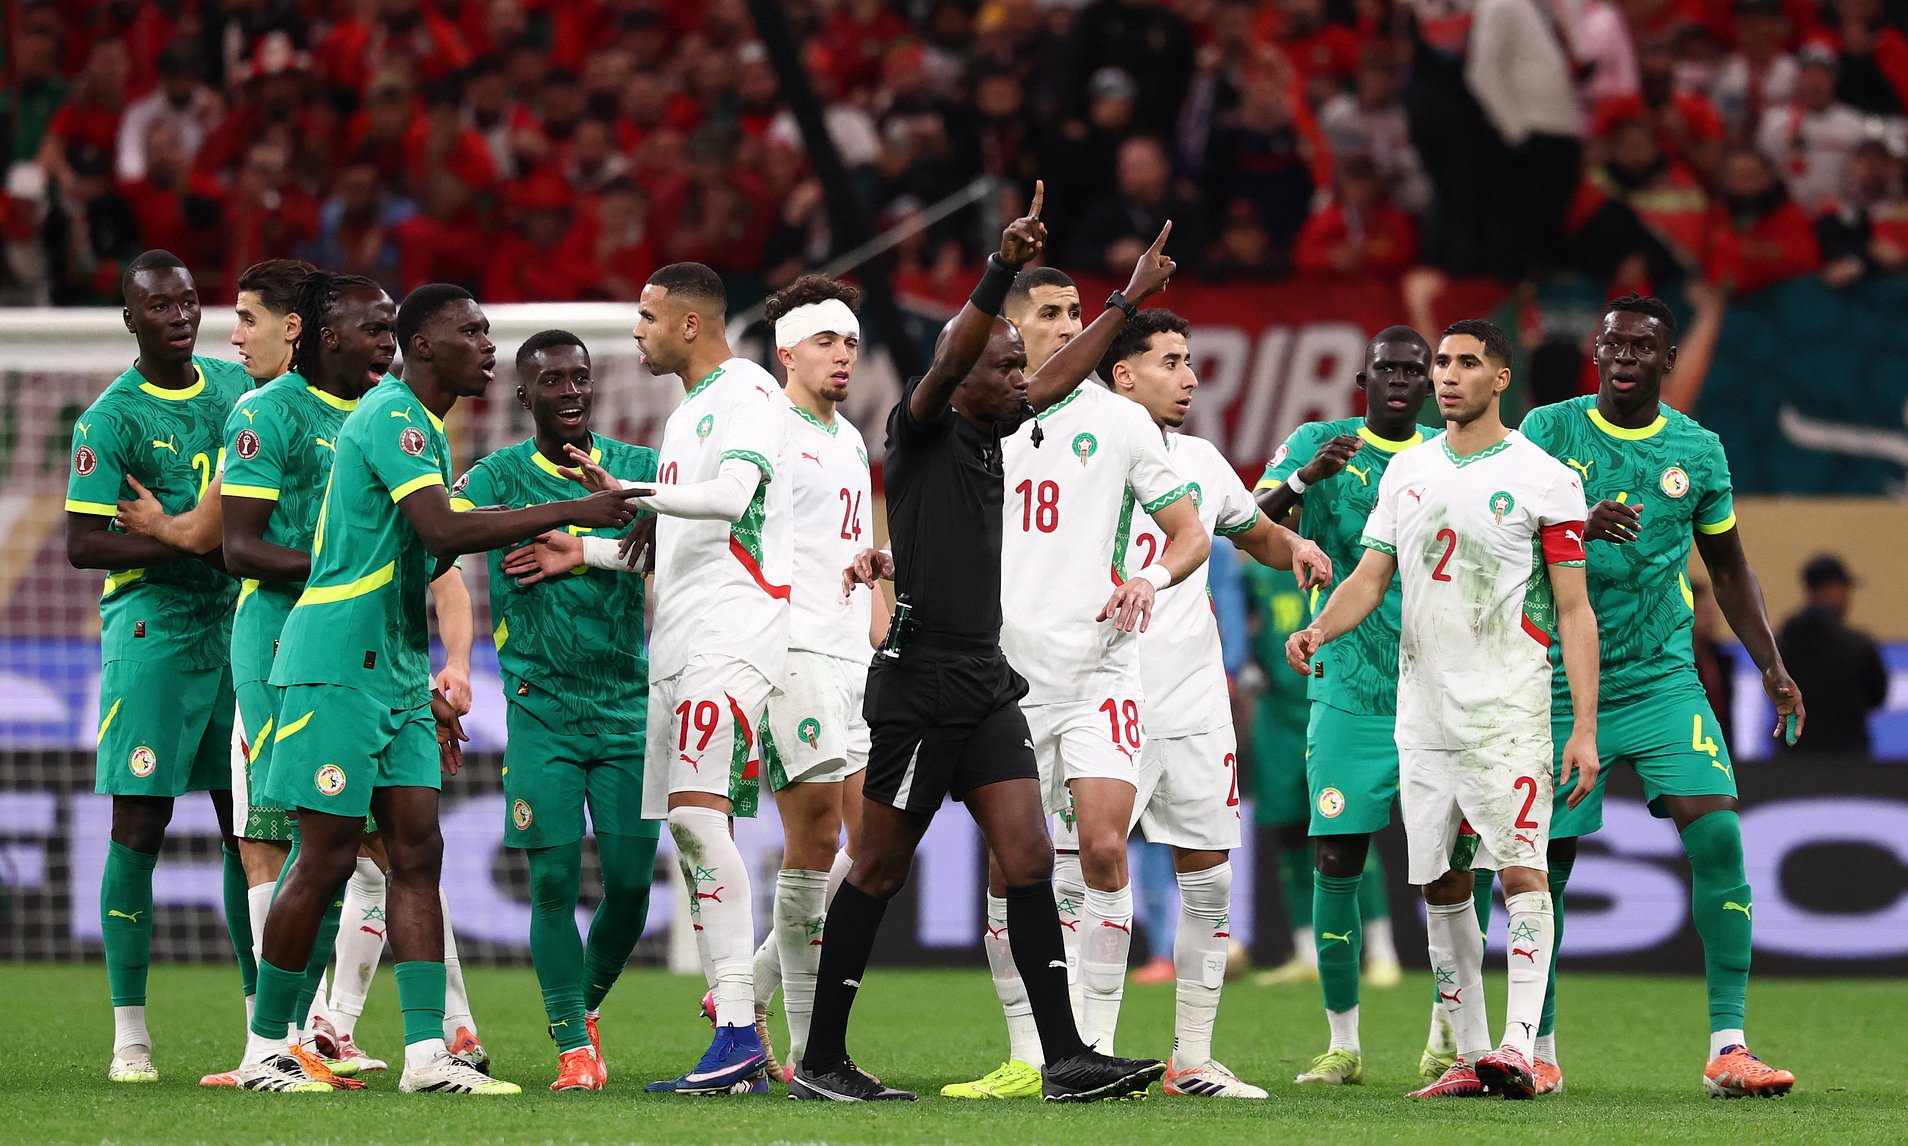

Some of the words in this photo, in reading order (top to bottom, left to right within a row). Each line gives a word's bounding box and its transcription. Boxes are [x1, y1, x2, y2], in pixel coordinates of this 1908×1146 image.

[840, 487, 862, 542] 24
[1015, 479, 1060, 533] 18
[1432, 528, 1457, 582] 2
[675, 700, 719, 751] 19
[1098, 698, 1140, 748] 18
[1692, 714, 1719, 757] 4
[1513, 775, 1538, 829] 2
